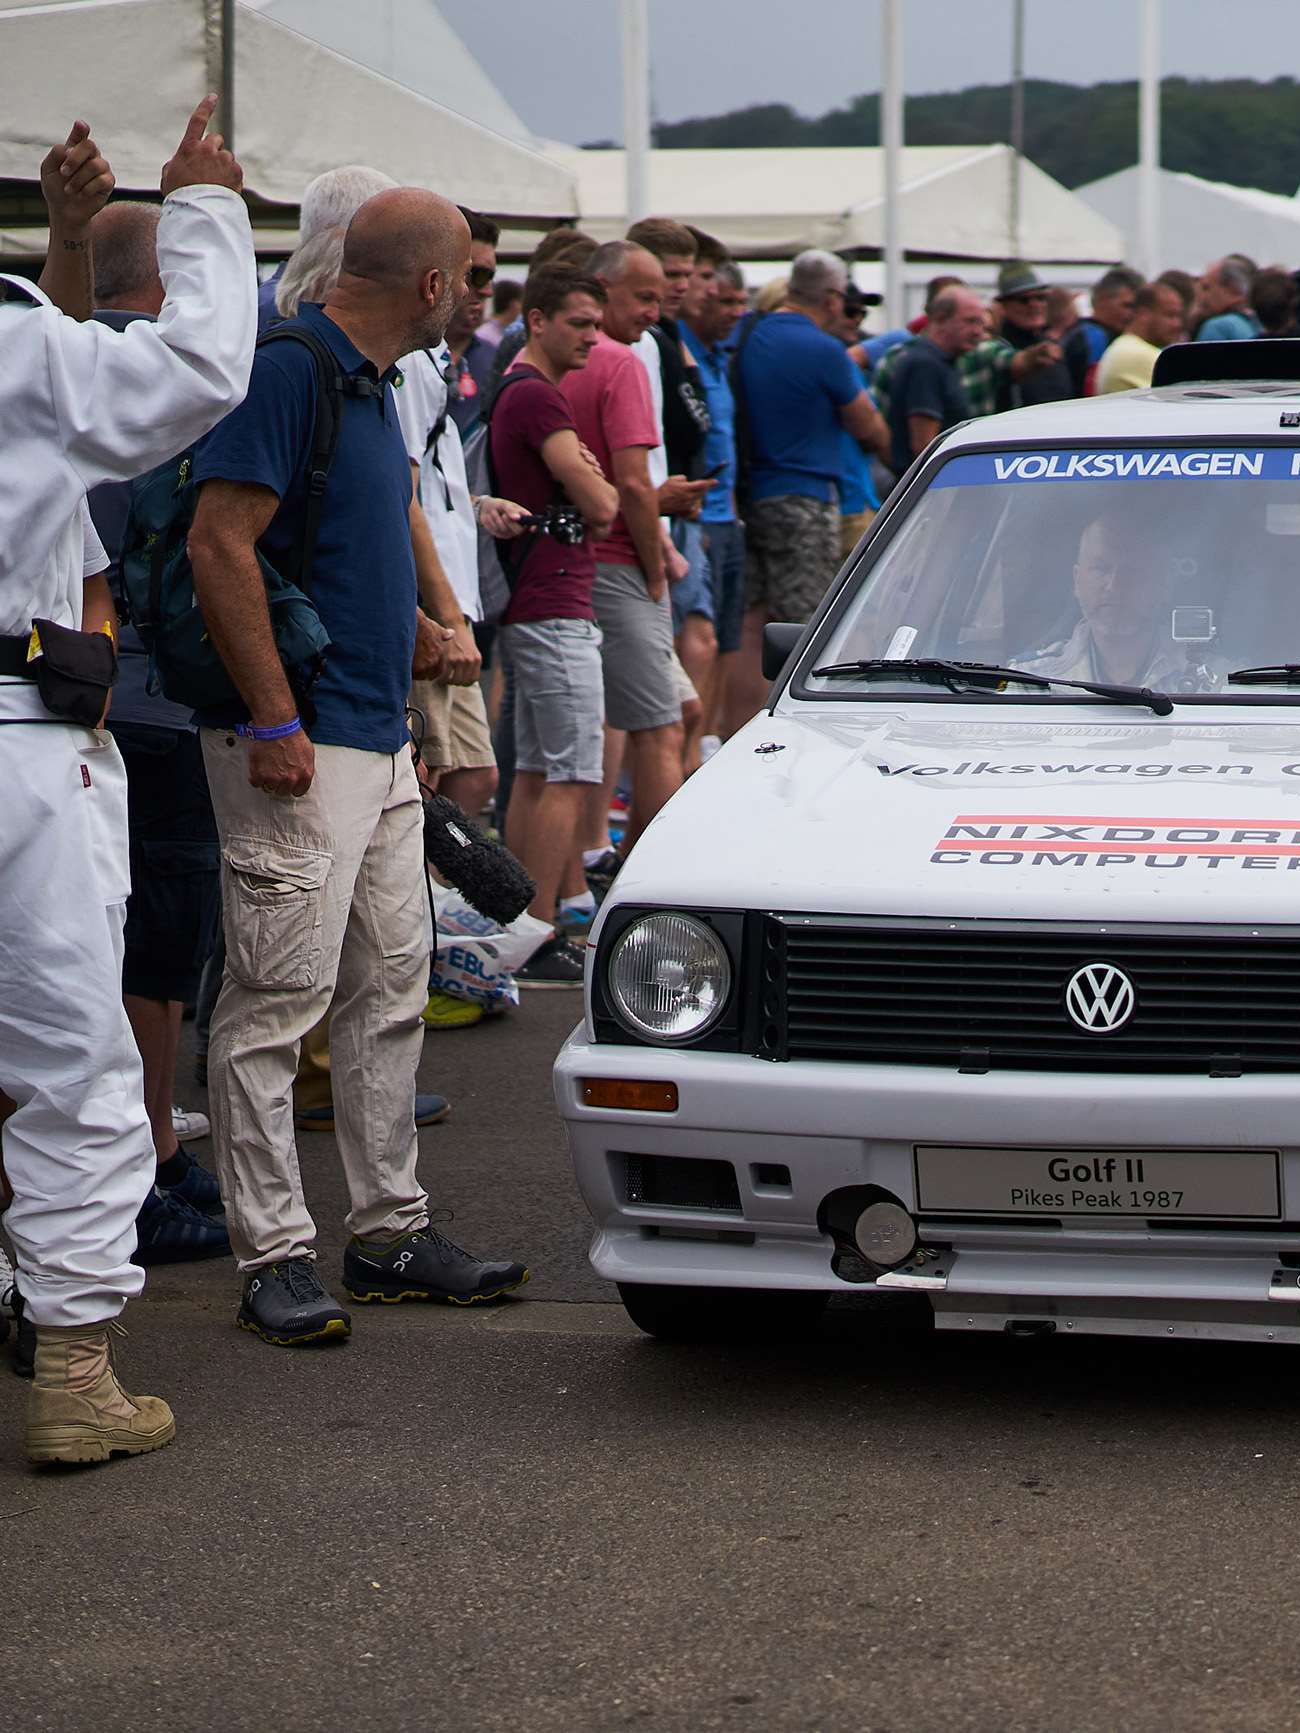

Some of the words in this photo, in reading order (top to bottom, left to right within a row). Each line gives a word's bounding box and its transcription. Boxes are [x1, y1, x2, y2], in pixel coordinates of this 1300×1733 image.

[993, 452, 1265, 480] VOLKSWAGEN
[876, 761, 1254, 778] Volkswagen
[1048, 1157, 1117, 1183] Golf
[1125, 1158, 1145, 1183] II
[1010, 1188, 1065, 1207] Pikes
[1071, 1189, 1122, 1208] Peak
[1130, 1190, 1184, 1209] 1987
